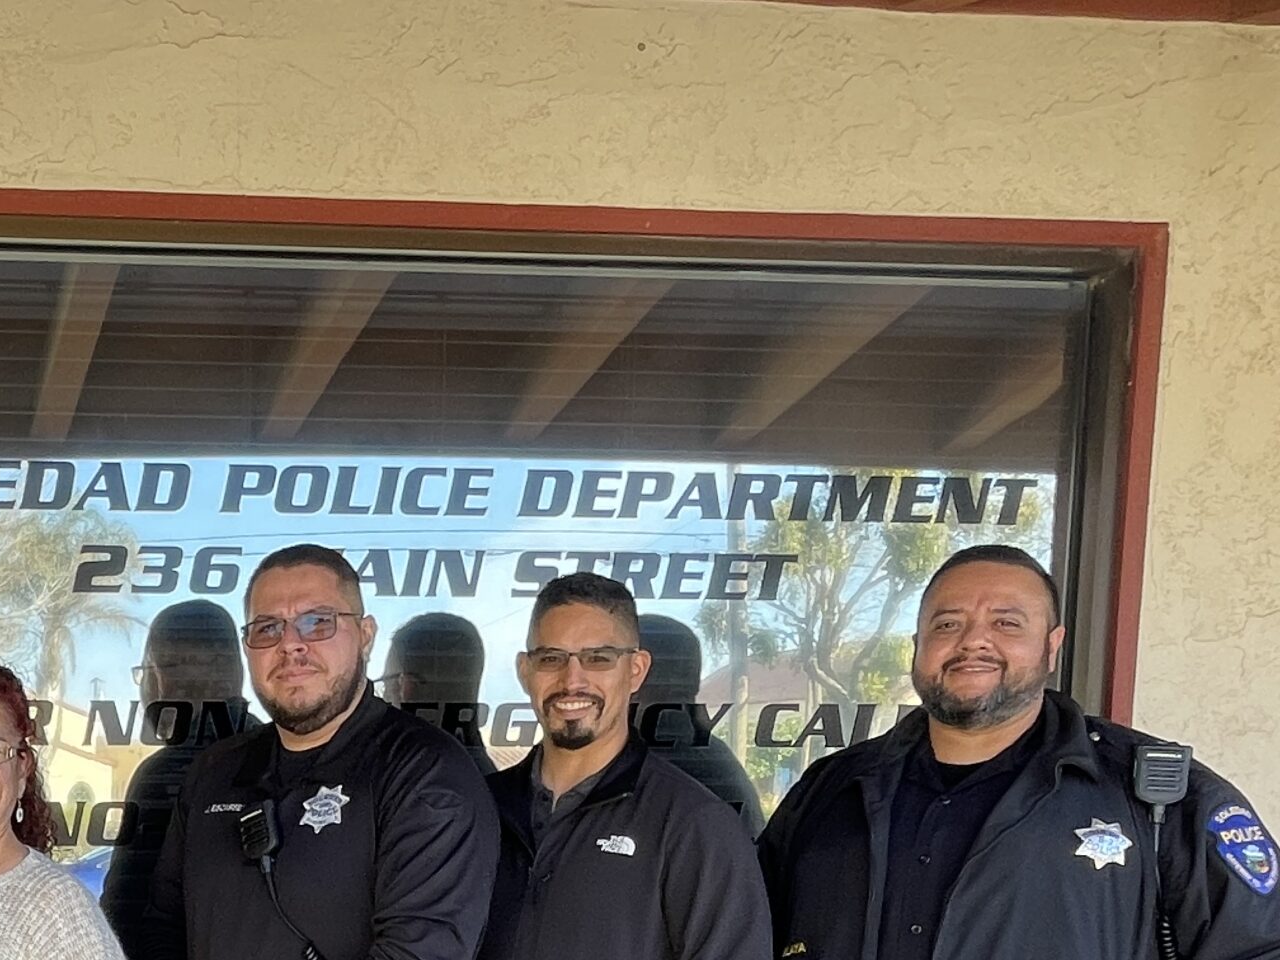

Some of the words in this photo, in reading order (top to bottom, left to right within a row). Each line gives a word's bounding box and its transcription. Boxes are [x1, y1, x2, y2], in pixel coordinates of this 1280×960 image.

[219, 463, 494, 517] POLICE
[516, 469, 1038, 525] DEPARTMENT
[72, 545, 243, 594] 236
[335, 549, 486, 598] AIN
[511, 551, 798, 600] STREET
[1220, 825, 1265, 845] POLICE
